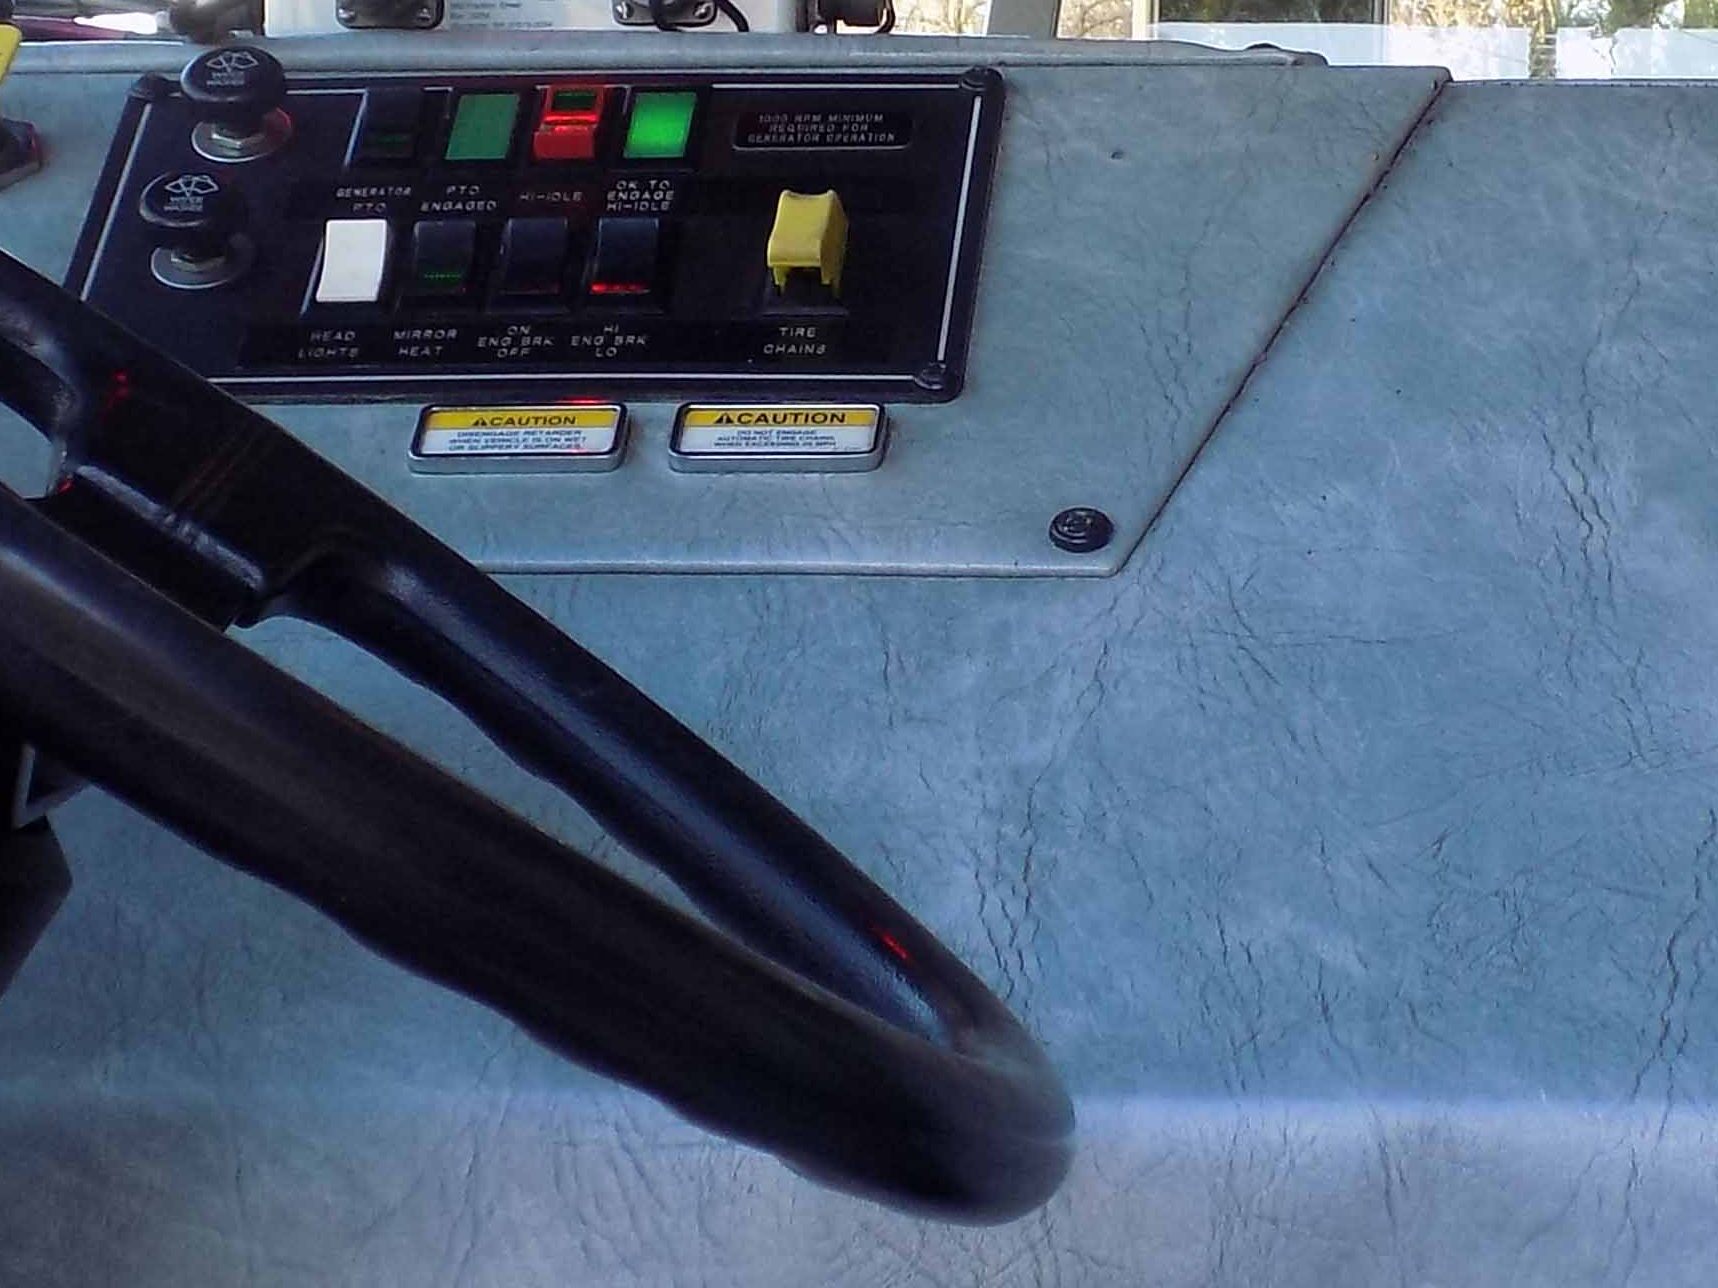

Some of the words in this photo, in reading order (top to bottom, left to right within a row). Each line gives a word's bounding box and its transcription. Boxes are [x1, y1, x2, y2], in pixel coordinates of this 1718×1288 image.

[794, 112, 822, 123] RPM
[828, 112, 884, 123] MINIMUM
[768, 122, 835, 133] REQUIRED
[840, 122, 869, 133] FOR
[747, 132, 819, 144] GENERATOR
[826, 132, 896, 144] OPERATION
[446, 185, 481, 196] PTO
[616, 179, 638, 190] OK
[648, 179, 671, 190] TO
[335, 186, 412, 198] GENERATOR
[519, 191, 583, 202] HI-IDLE
[606, 190, 676, 201] ENGAGE
[352, 202, 388, 213] PTO
[419, 200, 499, 212] ENGAGED
[605, 201, 671, 212] HI-IDLE
[391, 327, 459, 341] MIRROR
[506, 323, 531, 336] ON
[602, 323, 620, 335] HI
[778, 326, 817, 338] TIRE
[309, 329, 356, 342] HEAD
[476, 335, 516, 348] ENG
[519, 335, 555, 348] BRK
[569, 334, 608, 347] ENG
[613, 334, 648, 347] BRK
[297, 346, 359, 359] LIGHTS
[398, 345, 445, 358] HEAT
[496, 346, 532, 359] OFF
[594, 345, 619, 358] LO
[762, 343, 828, 356] CHAINS
[489, 415, 577, 426] CAUTION
[736, 412, 847, 425] CAUTION
[522, 429, 582, 437] RETARDER
[467, 443, 521, 451] SLIPPERY
